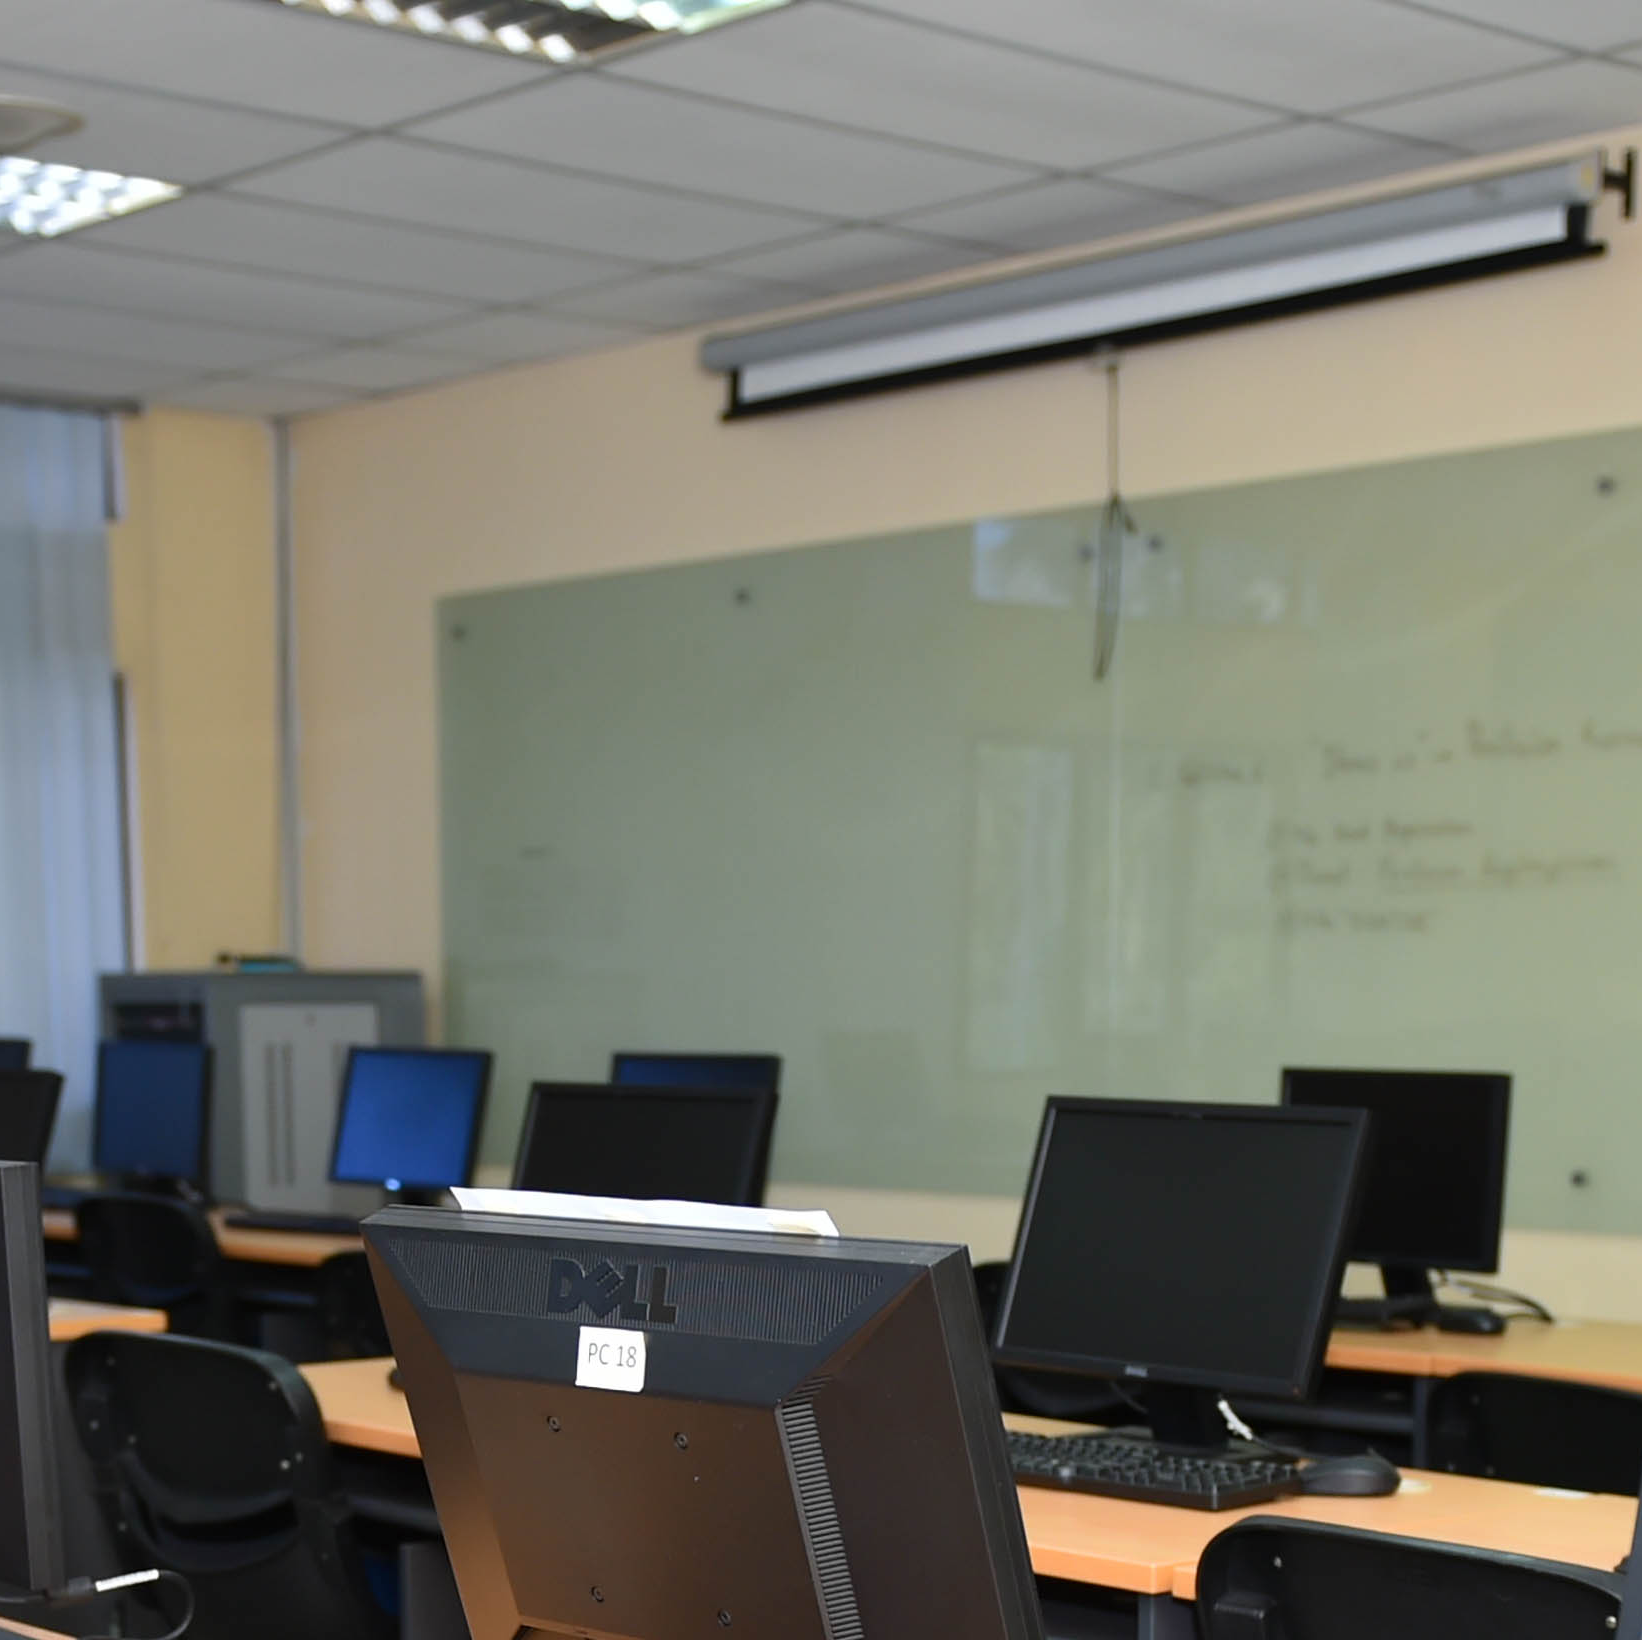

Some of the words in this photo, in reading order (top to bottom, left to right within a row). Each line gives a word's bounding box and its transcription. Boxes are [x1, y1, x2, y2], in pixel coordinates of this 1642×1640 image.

[547, 1256, 677, 1324] DELL
[588, 1343, 610, 1365] PC
[616, 1346, 637, 1368] 18
